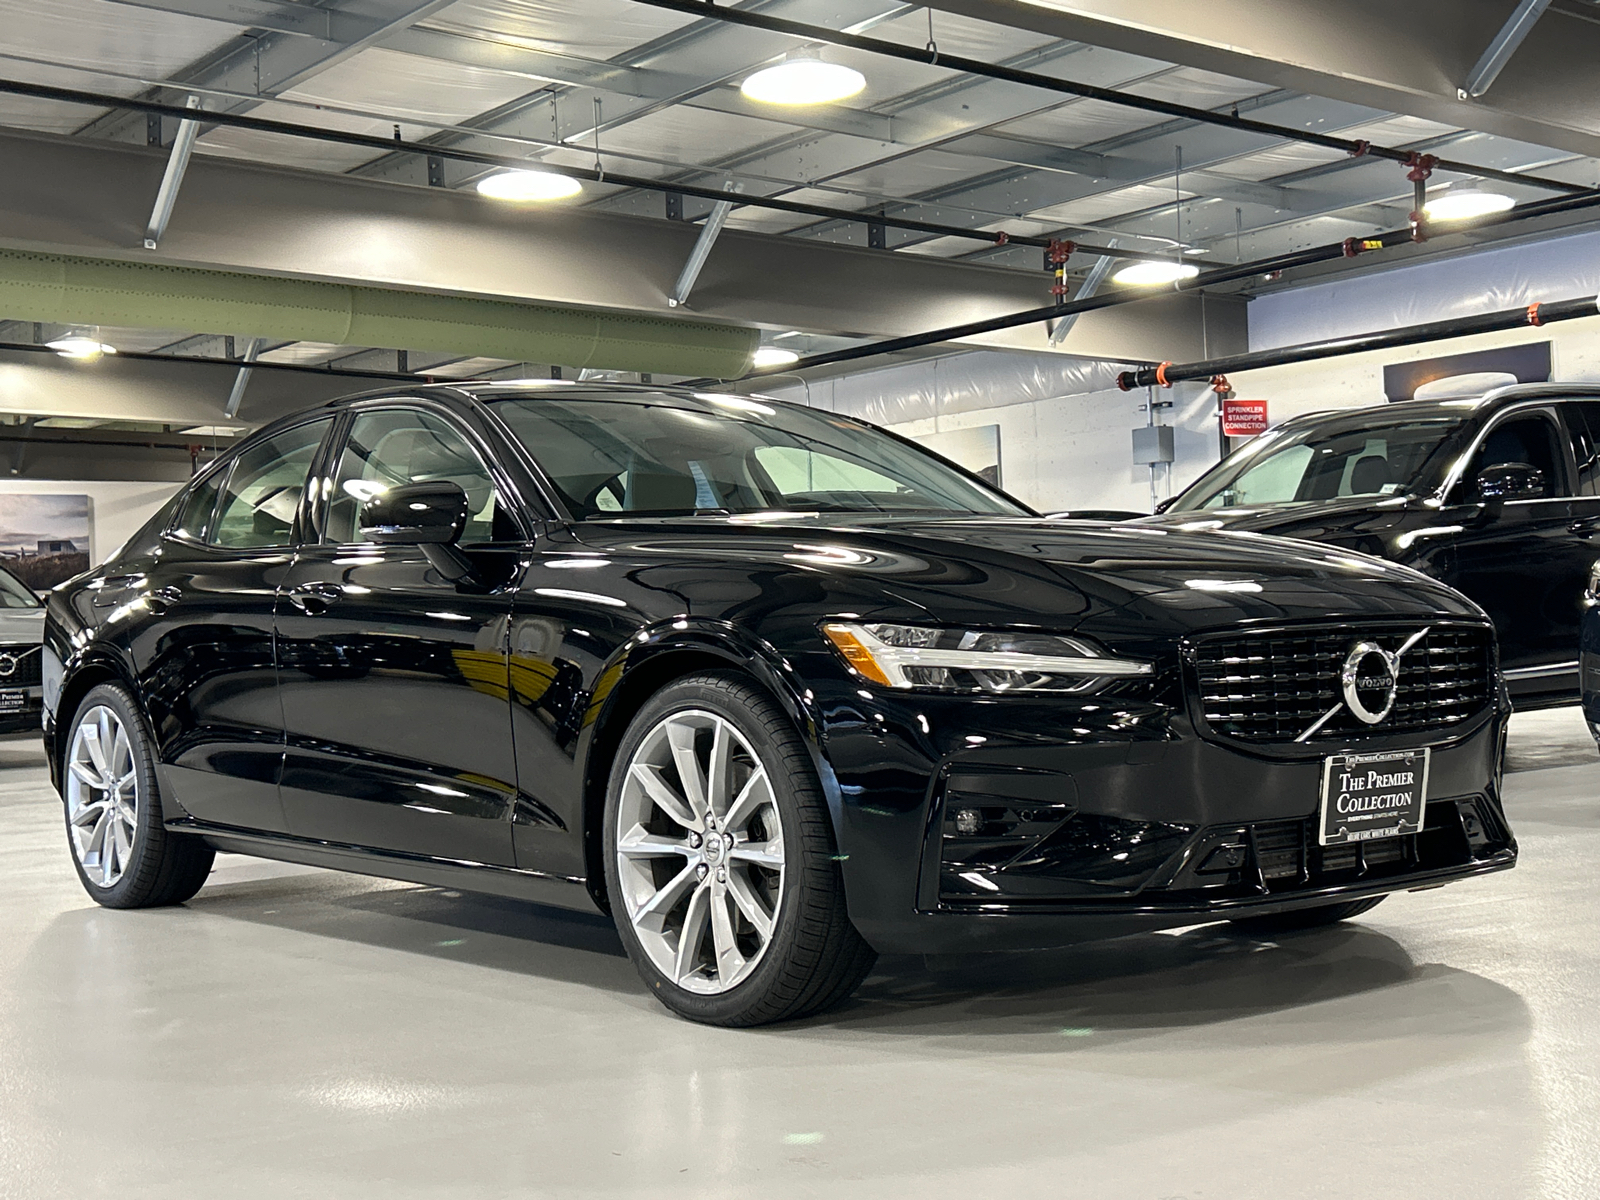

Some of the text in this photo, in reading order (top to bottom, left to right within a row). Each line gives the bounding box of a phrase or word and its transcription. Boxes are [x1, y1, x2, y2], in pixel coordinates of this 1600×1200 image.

[1359, 677, 1393, 688] VOLVO
[1339, 770, 1414, 792] THE PREMIER
[1336, 792, 1412, 813] COLLECTION
